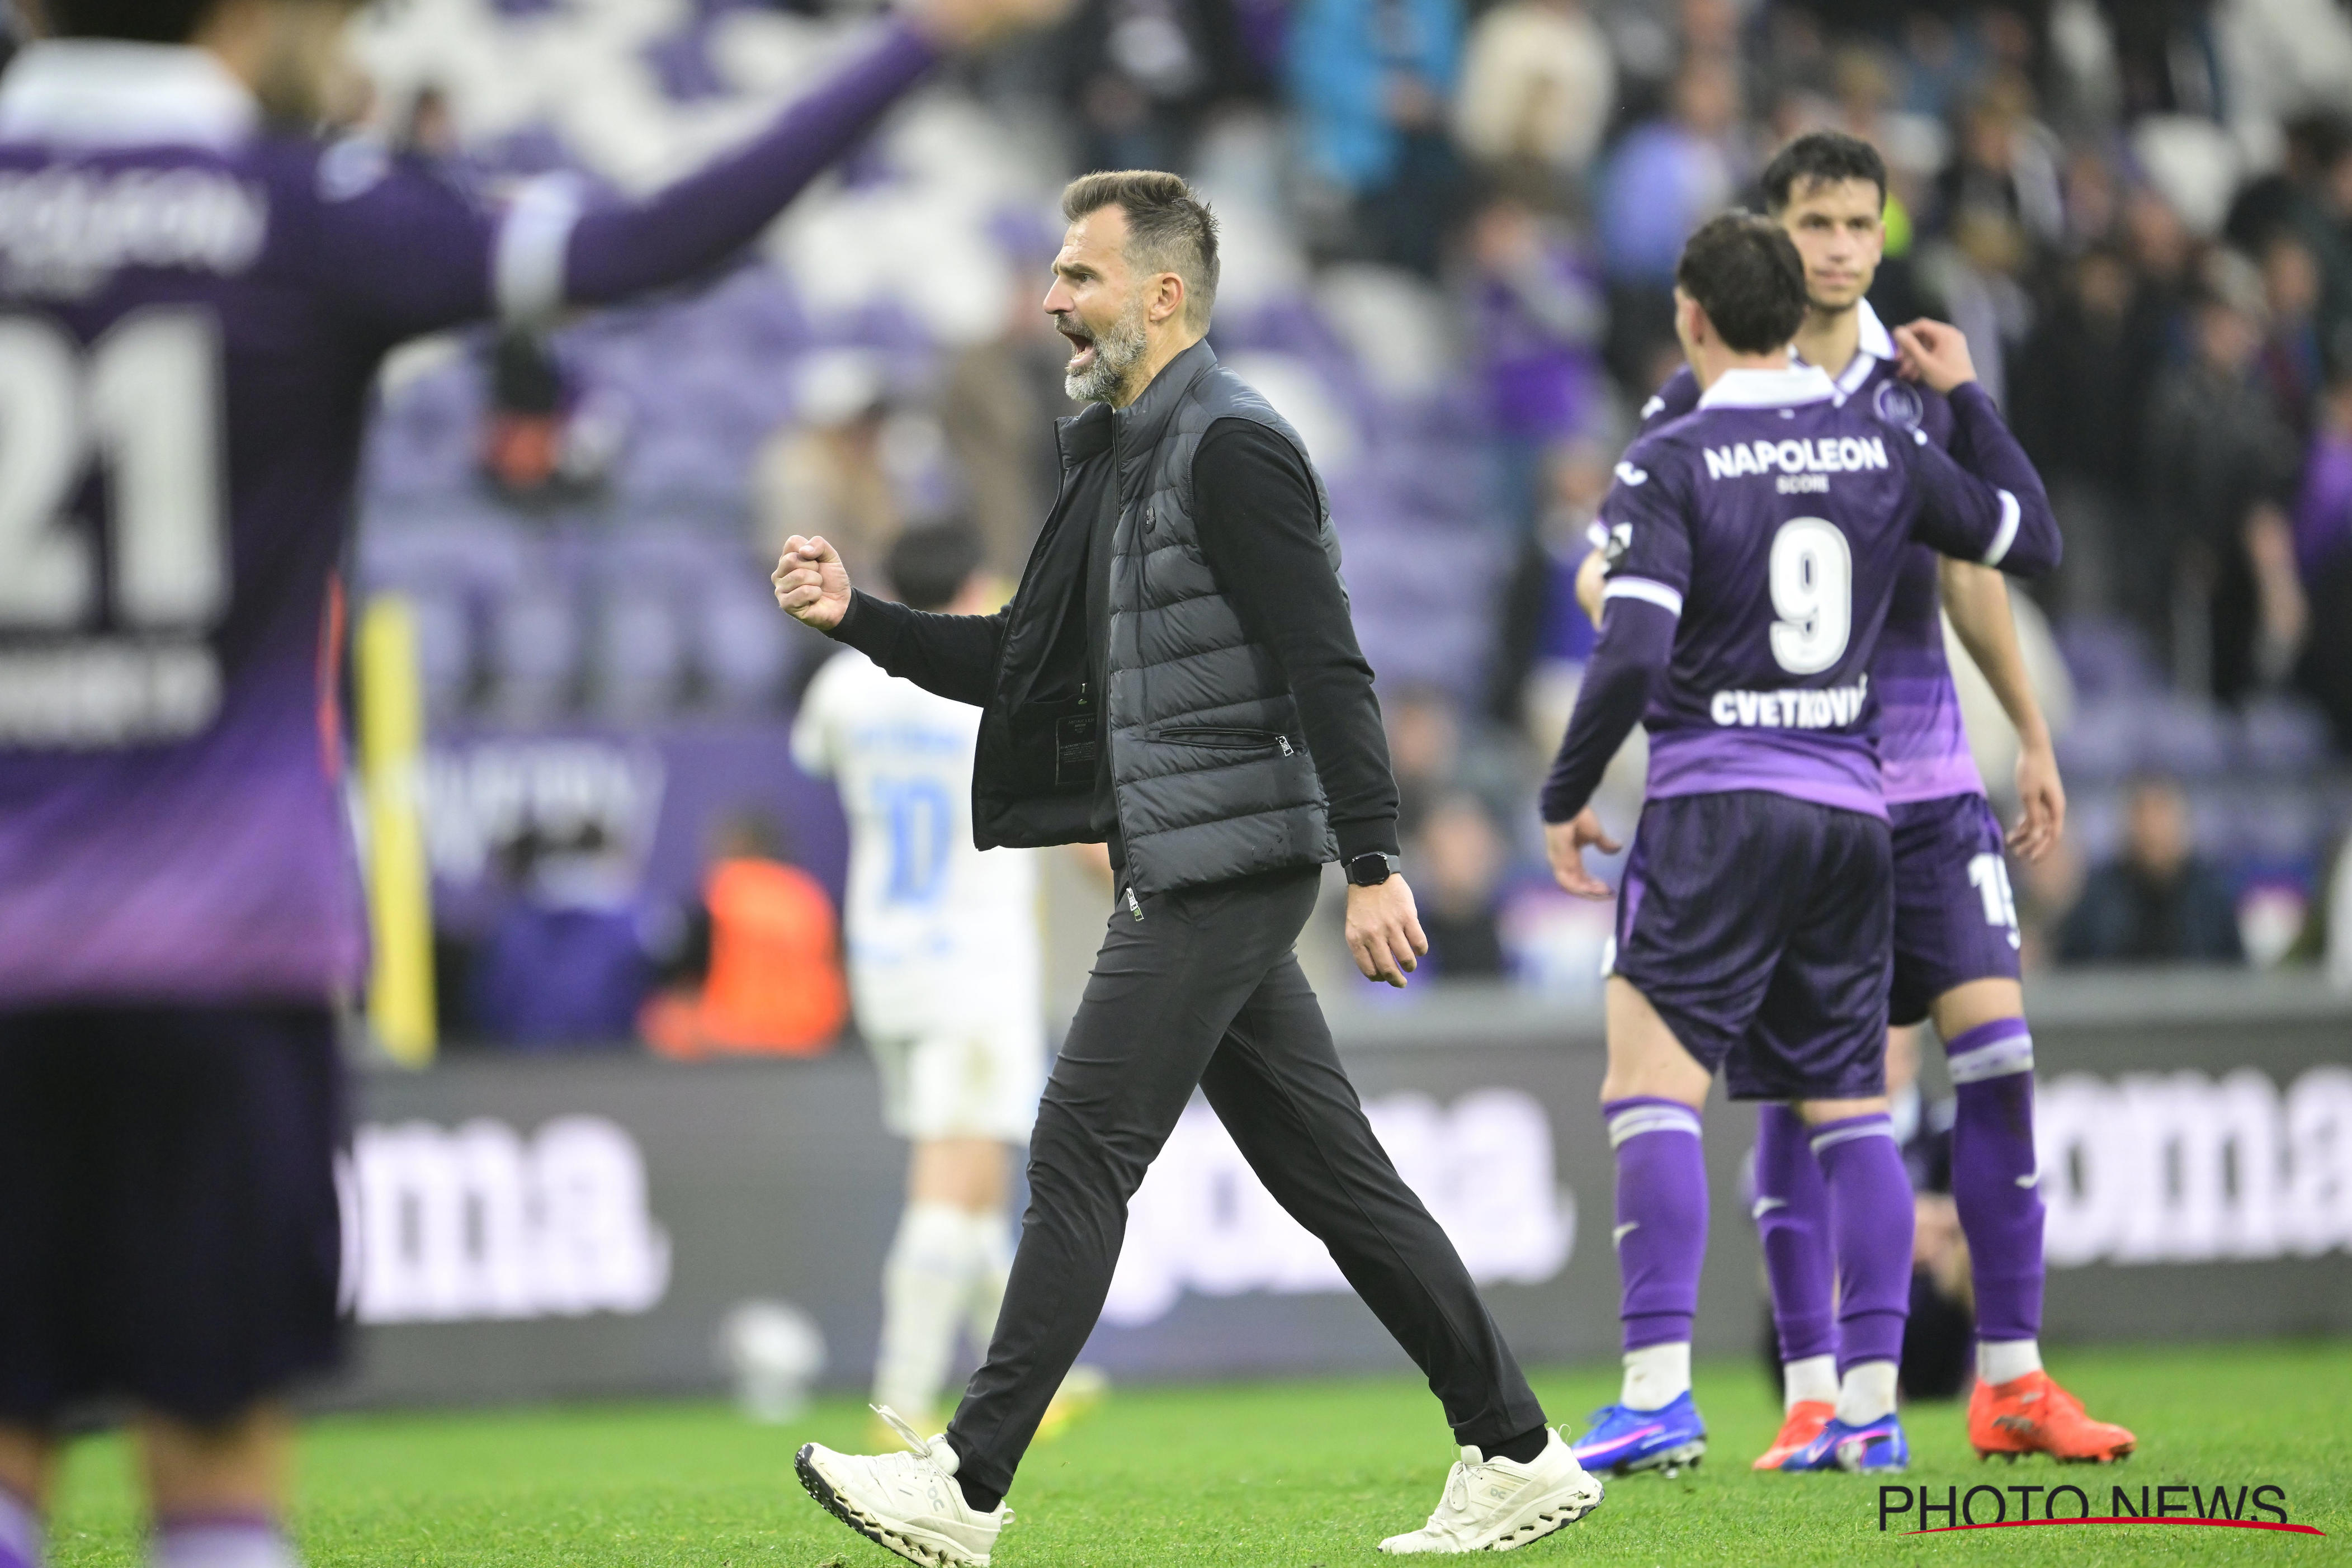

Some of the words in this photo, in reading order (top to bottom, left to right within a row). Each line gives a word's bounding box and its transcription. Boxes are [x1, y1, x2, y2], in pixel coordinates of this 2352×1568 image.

[0, 302, 230, 627] 21
[1703, 436, 1889, 480] NAPOLEON
[1769, 517, 1852, 674] 9
